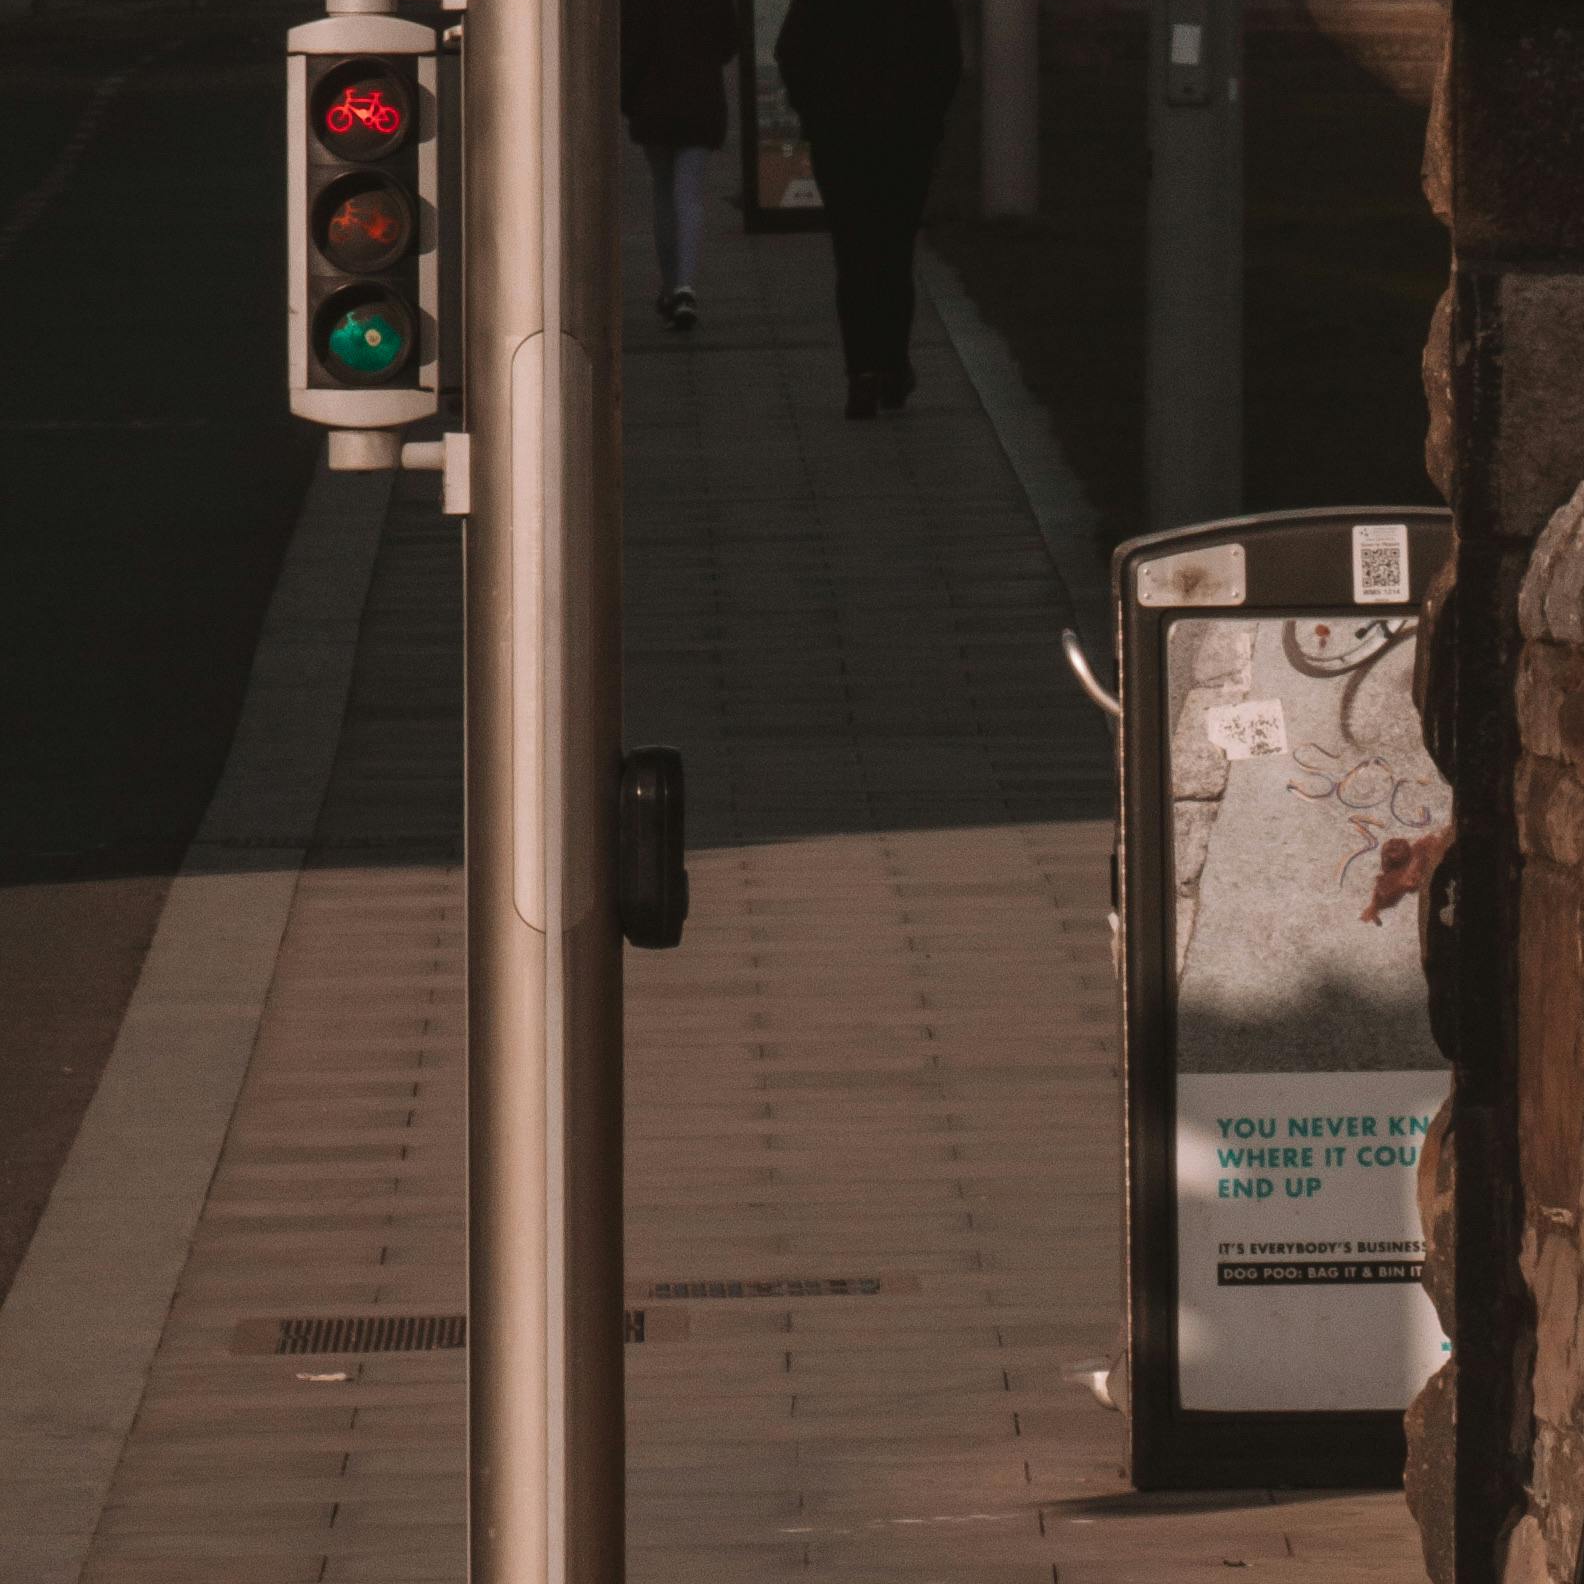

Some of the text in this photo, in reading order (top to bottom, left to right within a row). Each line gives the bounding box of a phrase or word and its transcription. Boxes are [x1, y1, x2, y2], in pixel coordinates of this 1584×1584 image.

[1216, 1118, 1277, 1139] YOU
[1287, 1117, 1377, 1137] NEVER
[1217, 1147, 1314, 1168] WHERE
[1325, 1147, 1346, 1167] IT
[1218, 1177, 1322, 1198] END UP
[1218, 1243, 1245, 1255] IT'S
[1250, 1241, 1352, 1255] EVERYBODY'S
[1223, 1268, 1258, 1280] DOG
[1263, 1267, 1303, 1279] POO:
[1308, 1266, 1339, 1278] BAG
[1344, 1266, 1358, 1278] IT
[1362, 1266, 1373, 1278] &
[1379, 1265, 1405, 1278] BIN
